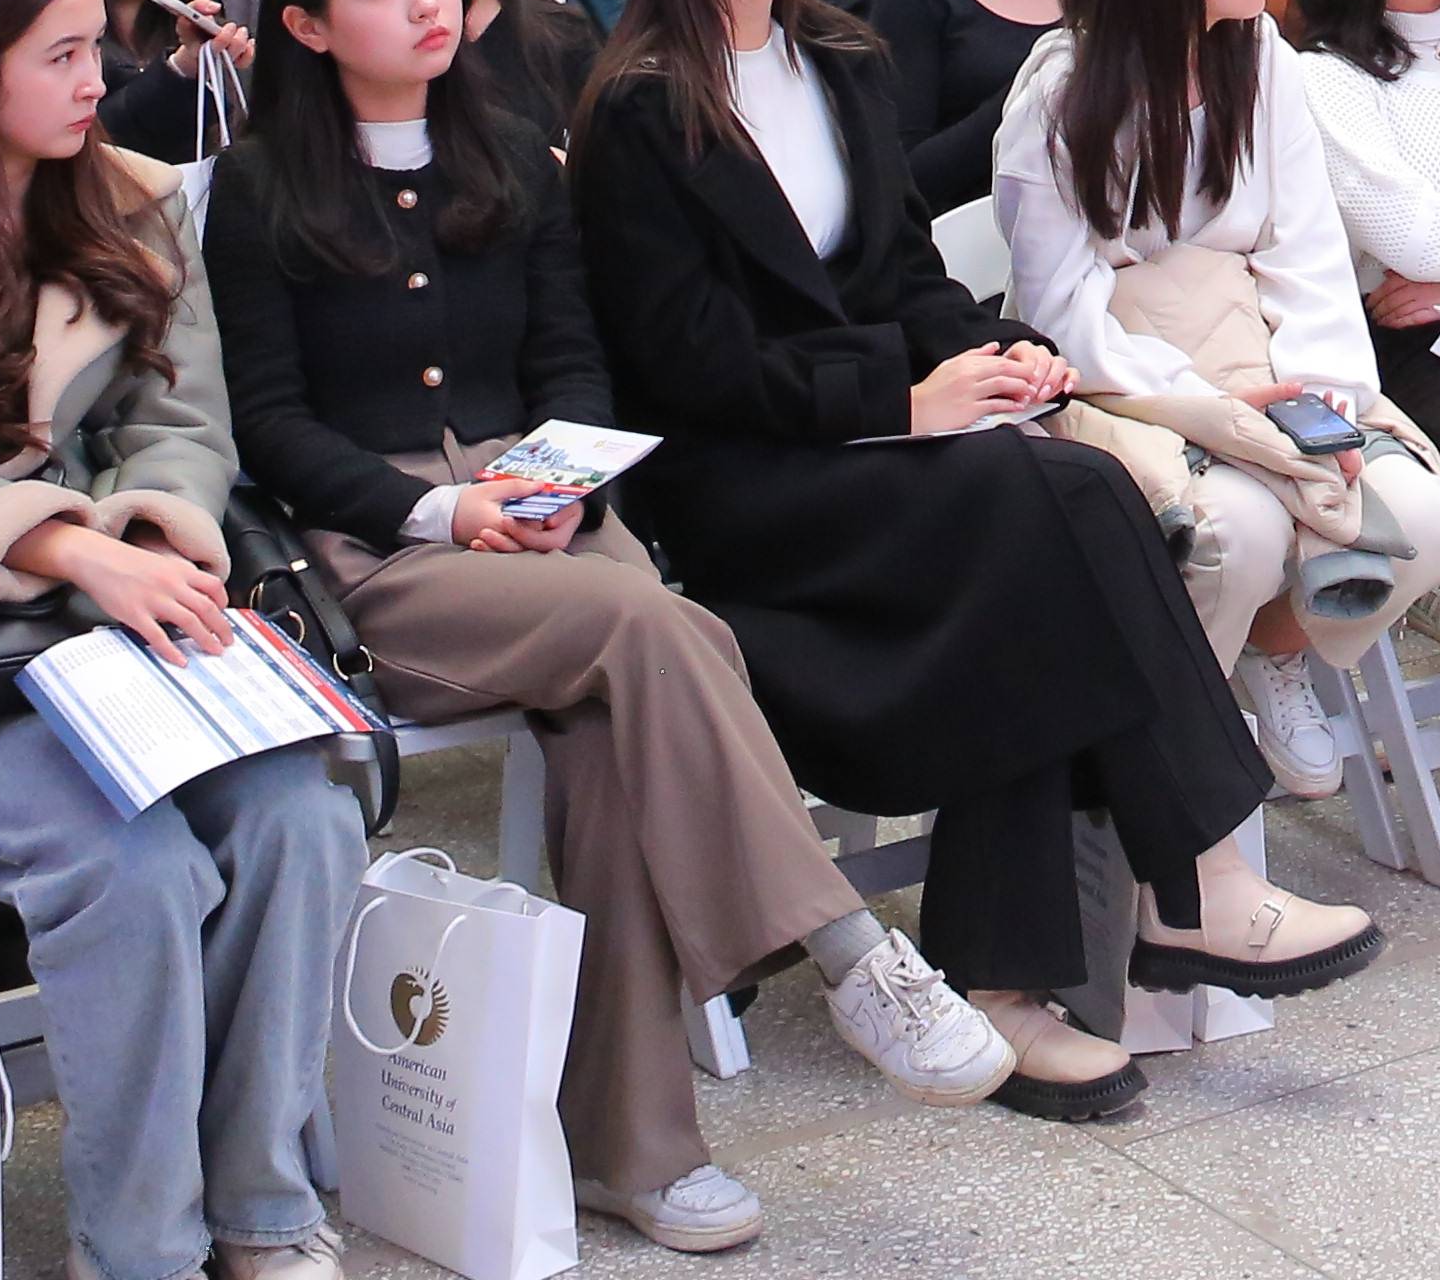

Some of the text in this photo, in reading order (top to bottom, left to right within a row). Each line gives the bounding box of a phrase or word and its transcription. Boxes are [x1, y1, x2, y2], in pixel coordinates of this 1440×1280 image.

[388, 1053, 448, 1081] American
[381, 1069, 457, 1112] University of
[381, 1095, 455, 1135] Central Asia
